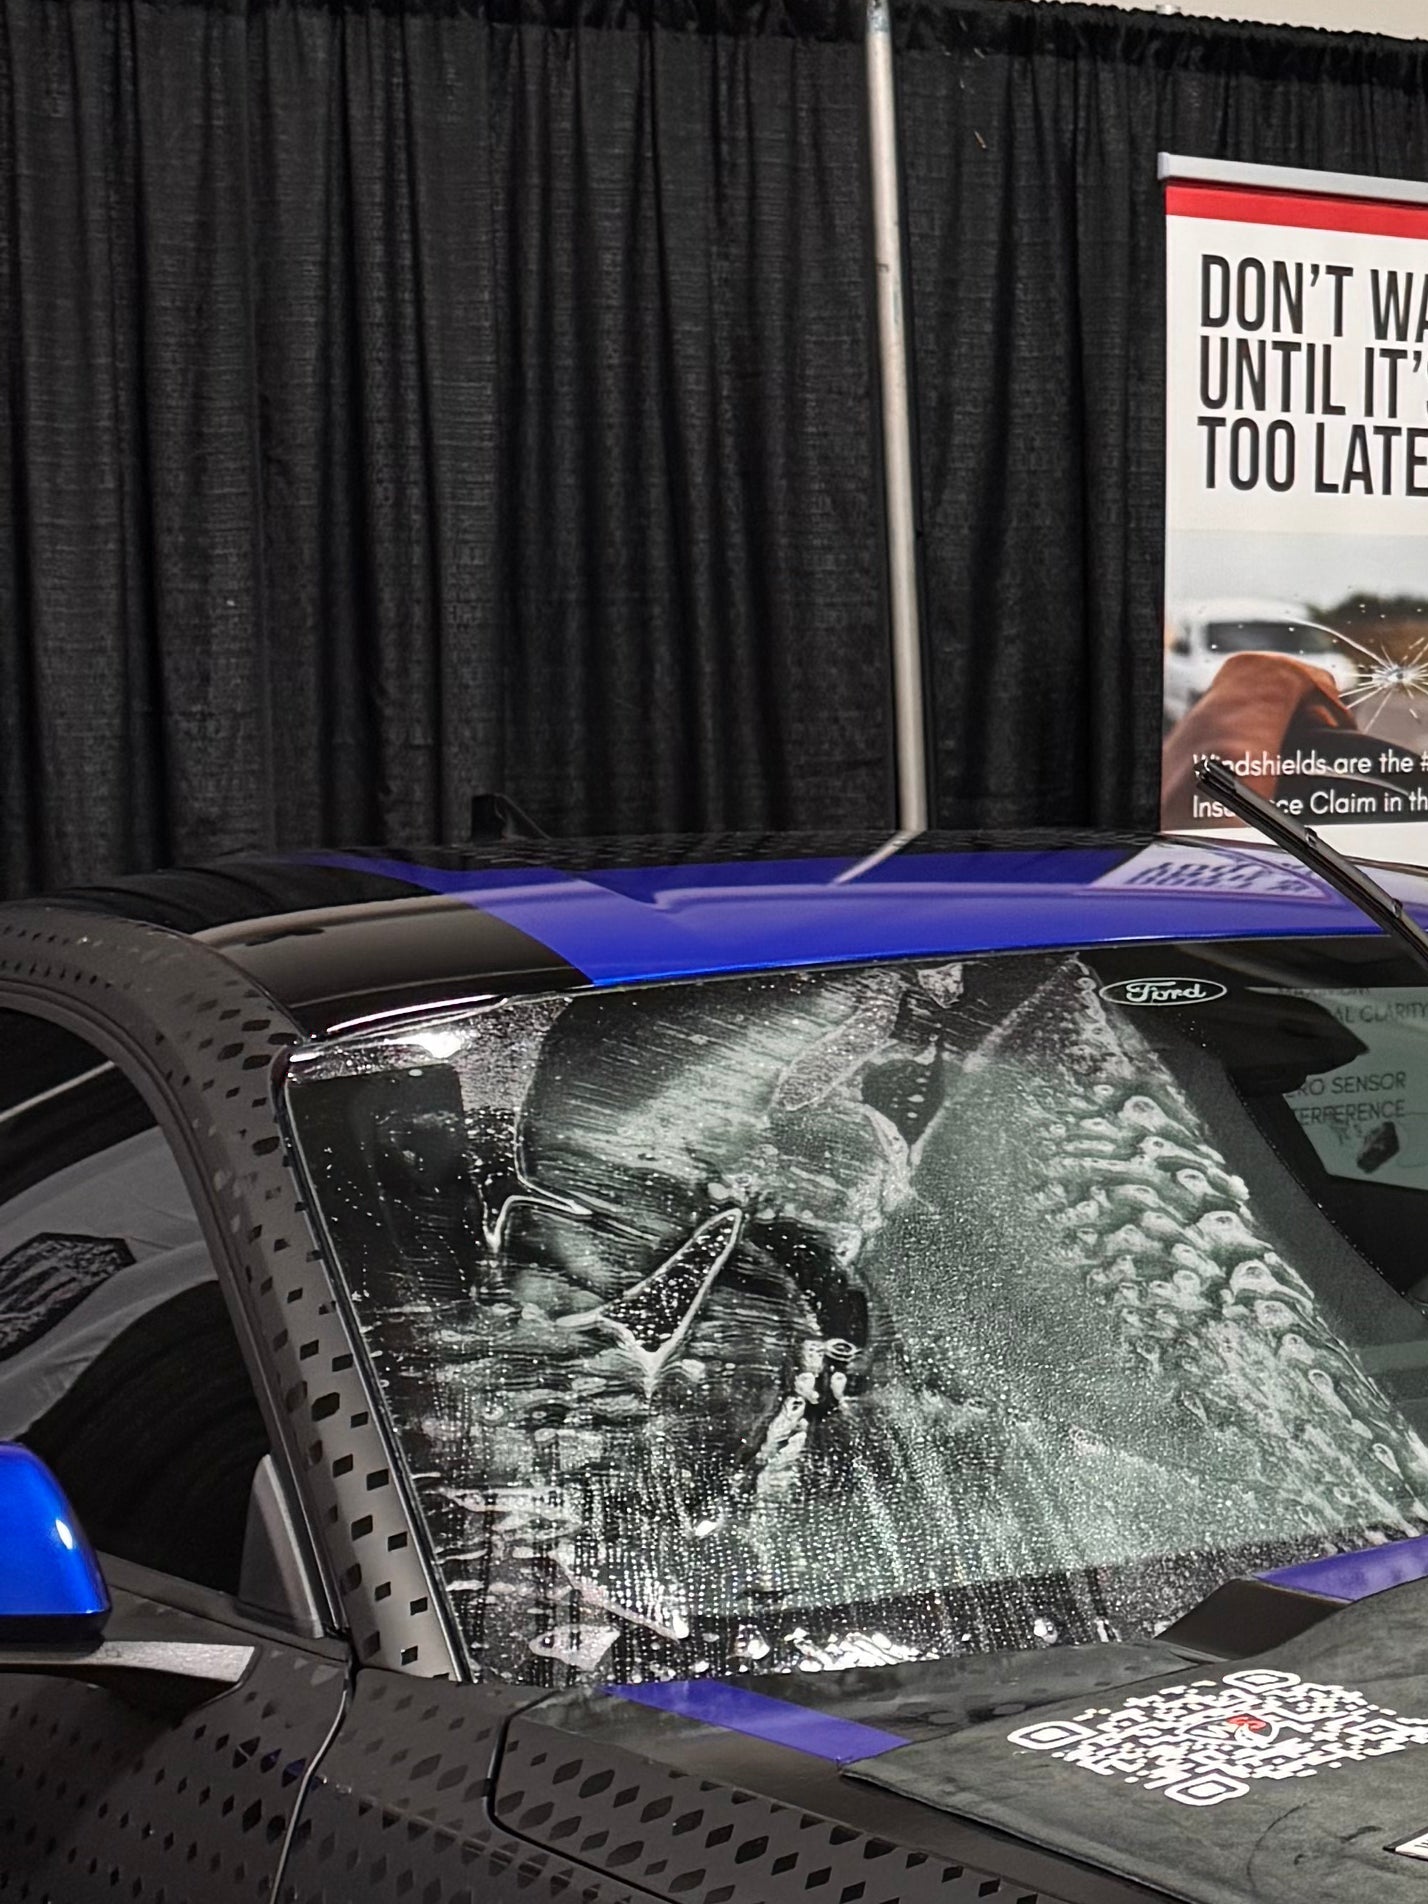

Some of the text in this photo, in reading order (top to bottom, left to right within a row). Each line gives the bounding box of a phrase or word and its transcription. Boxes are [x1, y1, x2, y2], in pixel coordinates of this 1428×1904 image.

[1200, 254, 1354, 337] DON'T
[1200, 335, 1347, 417] UNTIL
[1196, 416, 1296, 492] TOO
[1334, 756, 1373, 775] are
[1379, 749, 1414, 774] the
[1310, 791, 1377, 815] Claim
[1383, 792, 1401, 813] in
[1126, 981, 1208, 1003] Ford
[1330, 1071, 1408, 1095] SENSOR
